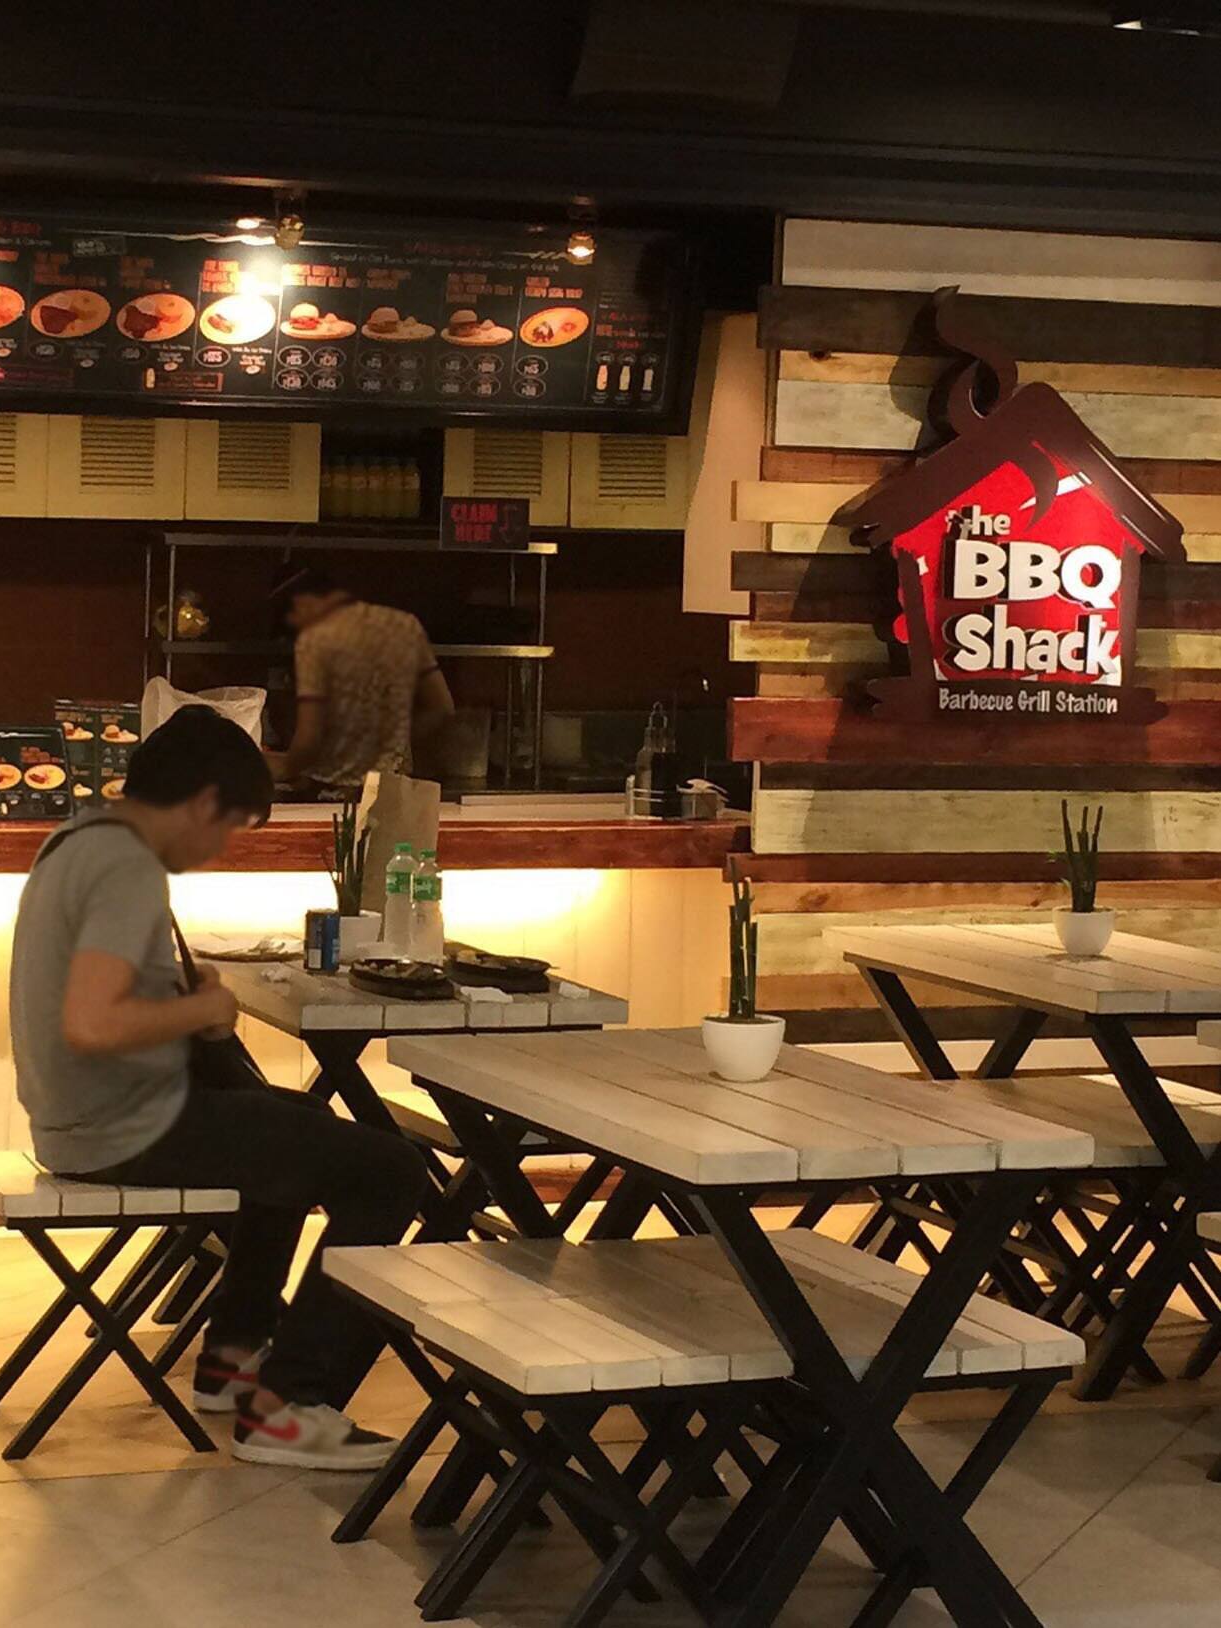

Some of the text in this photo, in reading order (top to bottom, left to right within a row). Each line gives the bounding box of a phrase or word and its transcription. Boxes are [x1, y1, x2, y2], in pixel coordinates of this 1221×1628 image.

[945, 505, 1011, 538] the
[953, 539, 1122, 609] BBQ
[953, 604, 1119, 675] Shack
[939, 688, 1118, 714] Barbecue Grill Station
